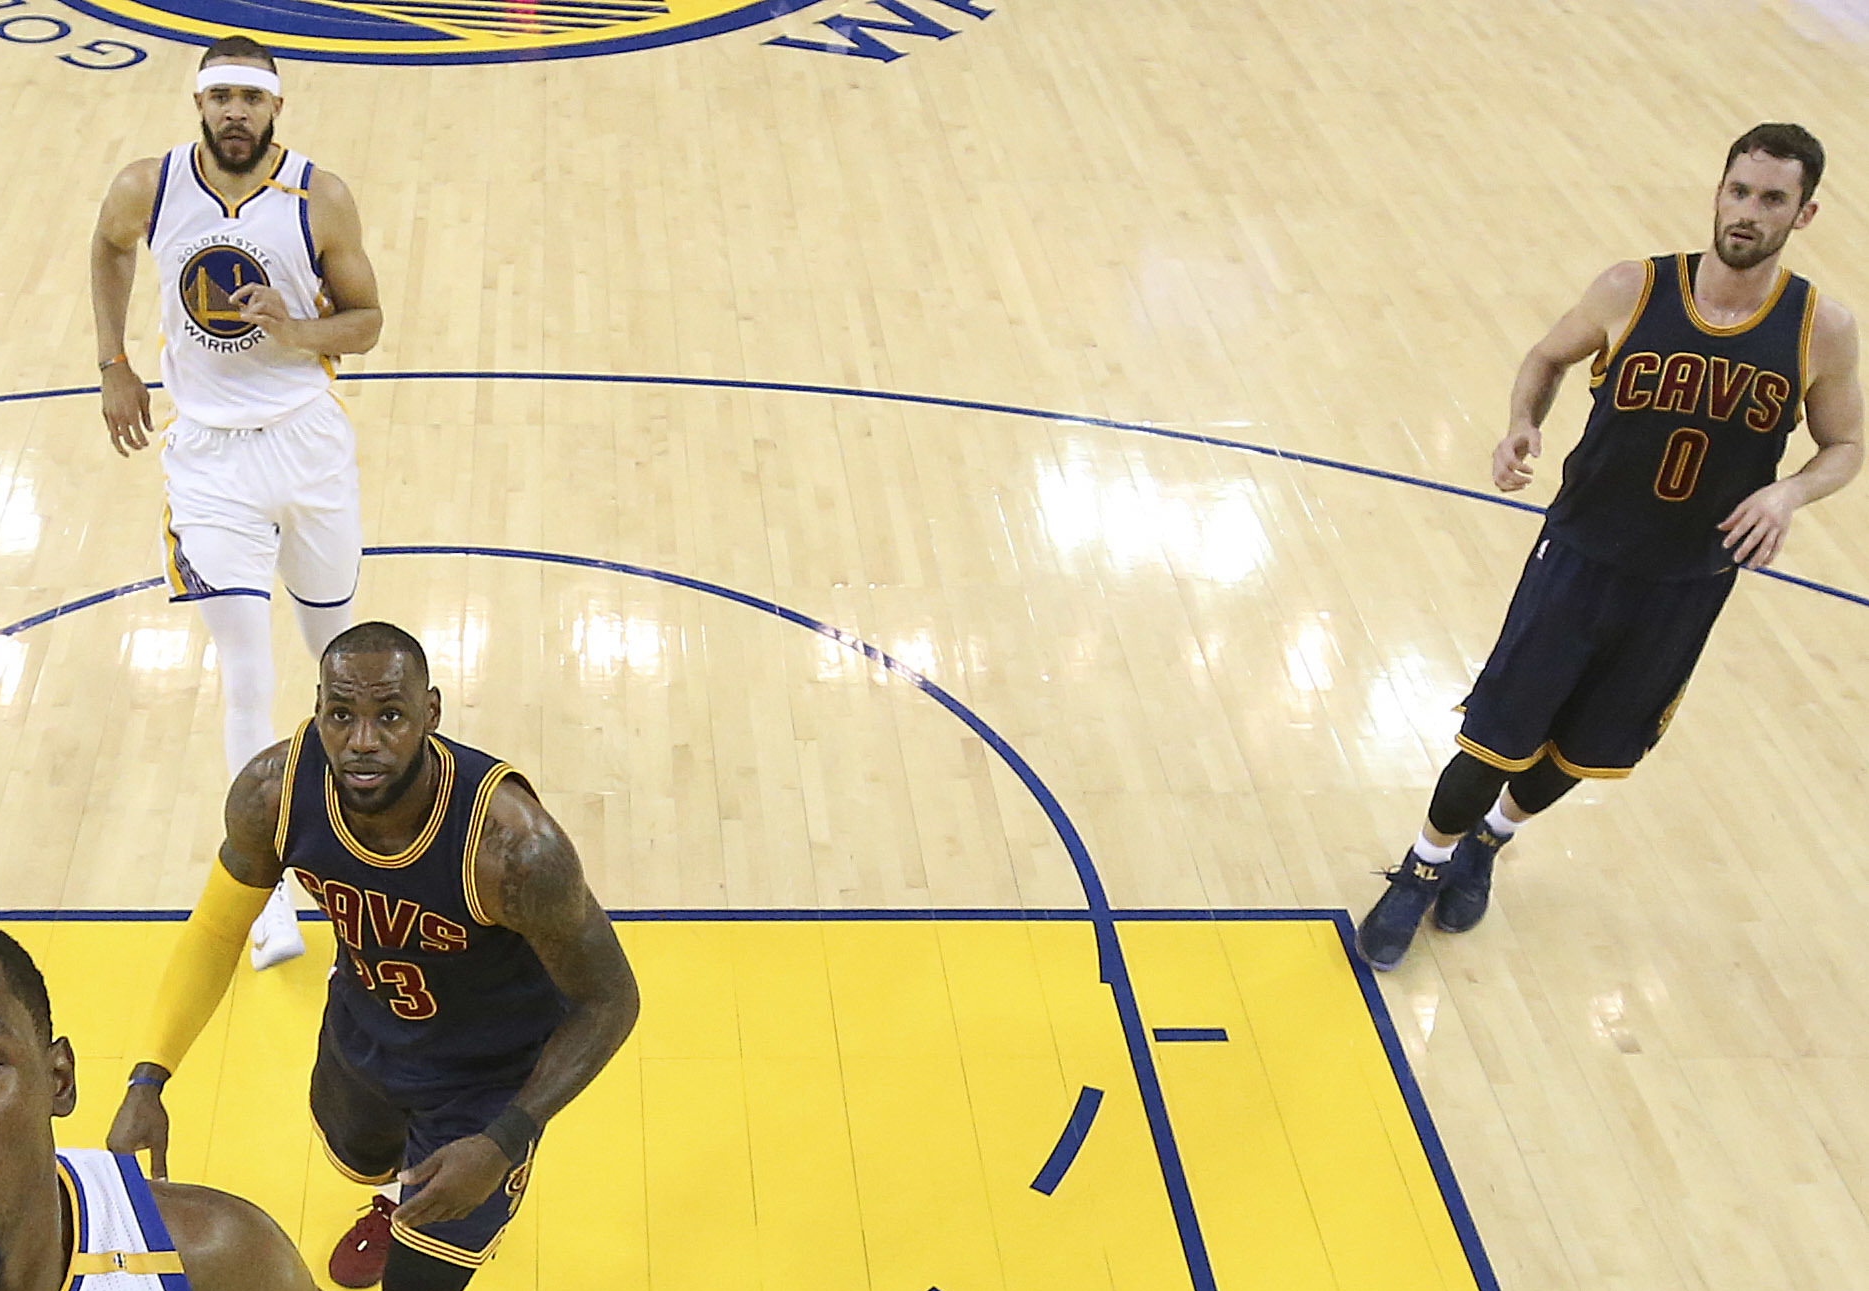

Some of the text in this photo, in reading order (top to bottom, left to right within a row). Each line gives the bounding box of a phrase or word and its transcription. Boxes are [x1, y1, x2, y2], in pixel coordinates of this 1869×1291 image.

[236, 238, 272, 268] STATE
[184, 320, 266, 354] WARRIOR
[1614, 352, 1790, 432] CAVS
[1654, 427, 1710, 501] 0
